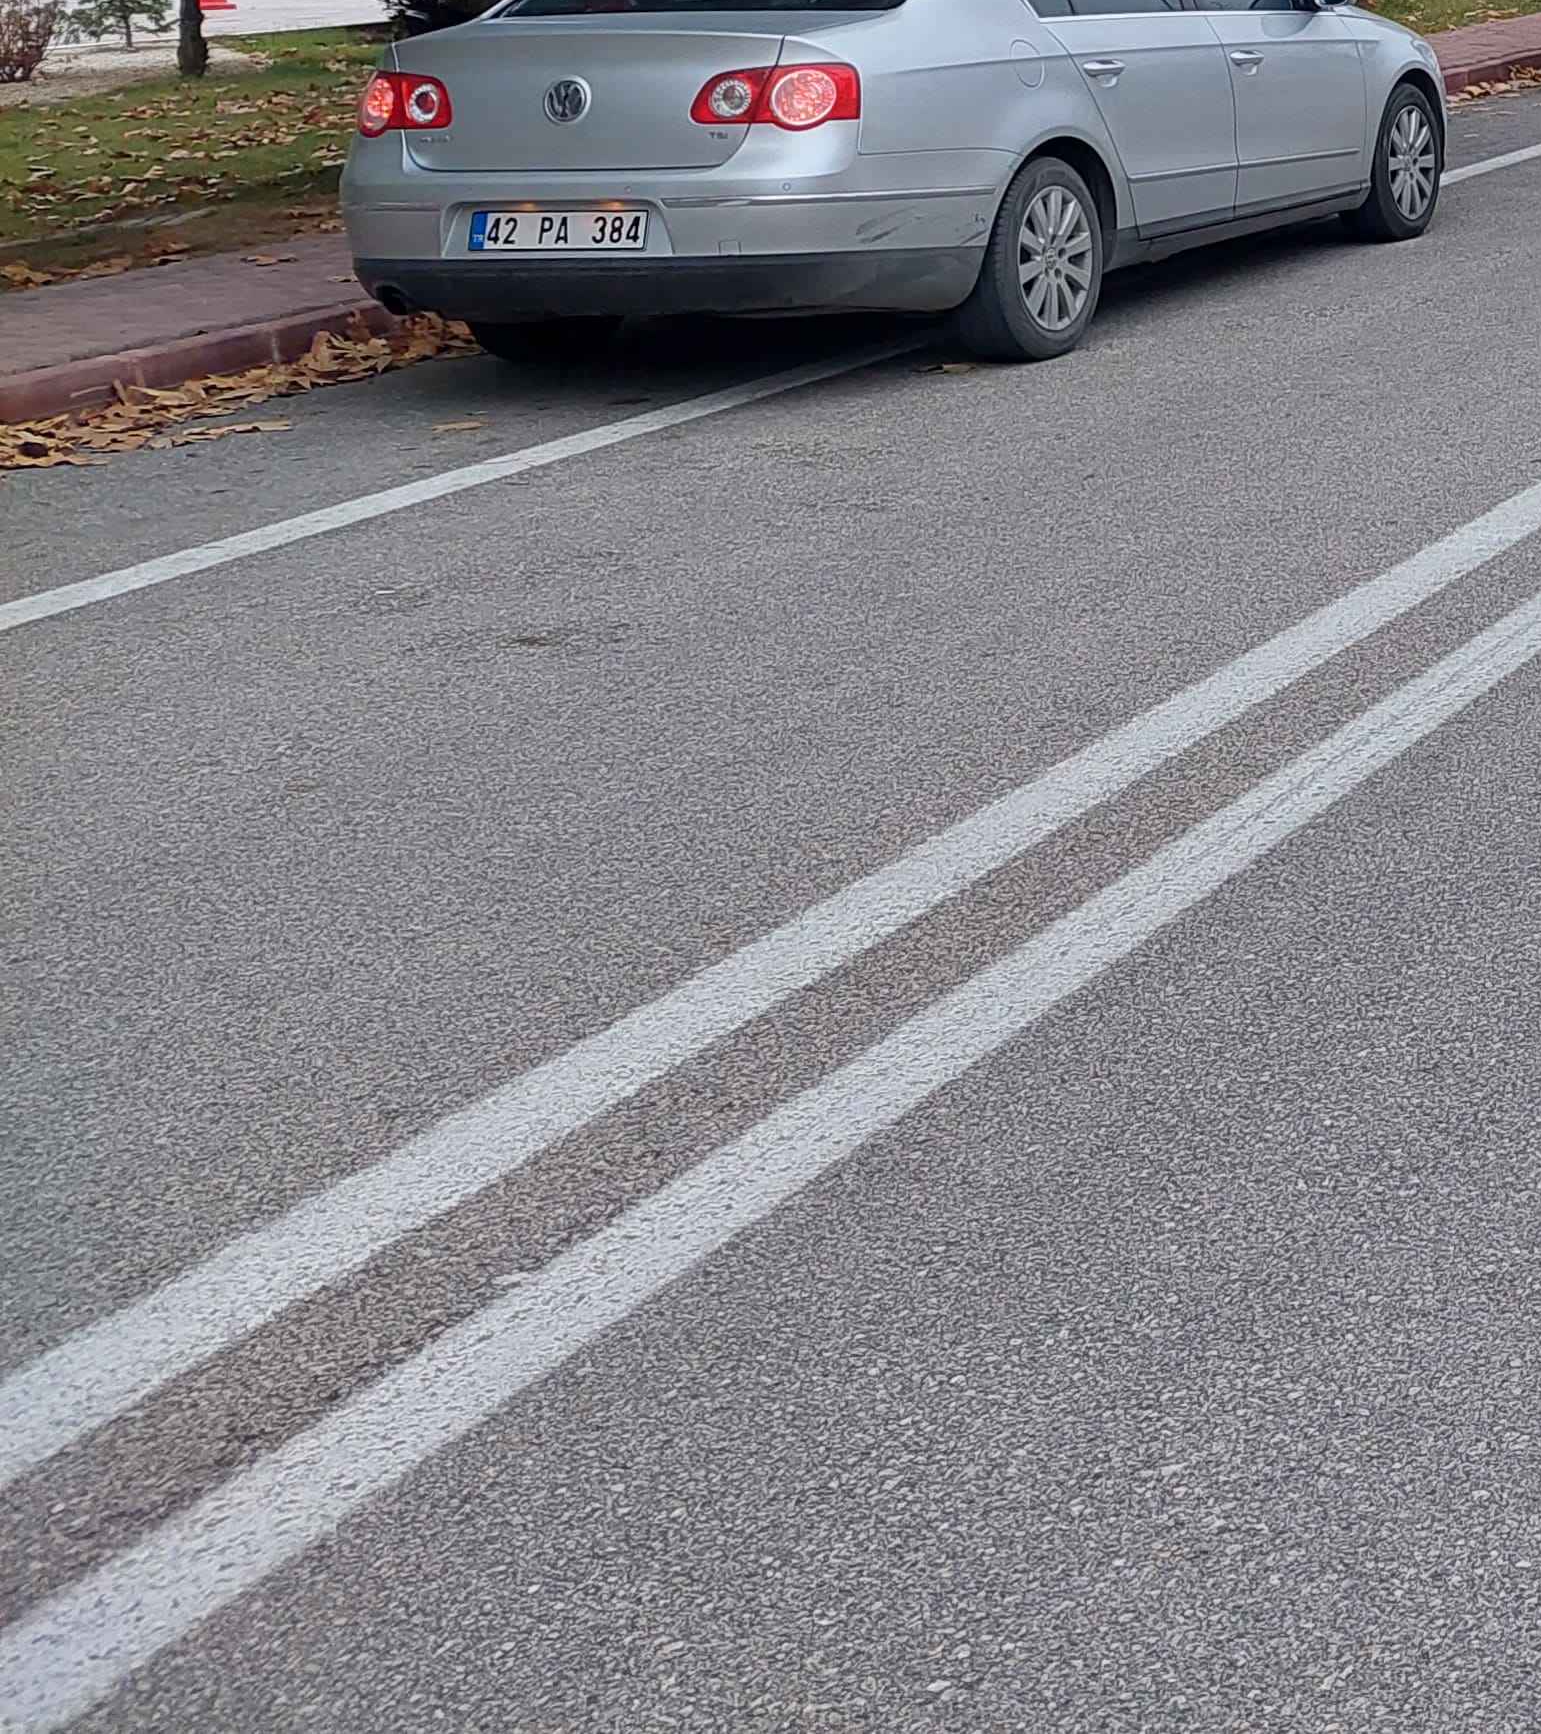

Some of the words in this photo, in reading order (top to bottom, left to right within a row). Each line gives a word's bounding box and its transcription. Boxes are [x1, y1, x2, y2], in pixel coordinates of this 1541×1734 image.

[487, 217, 518, 244] 42
[538, 217, 569, 244] PA
[592, 216, 641, 244] 384
